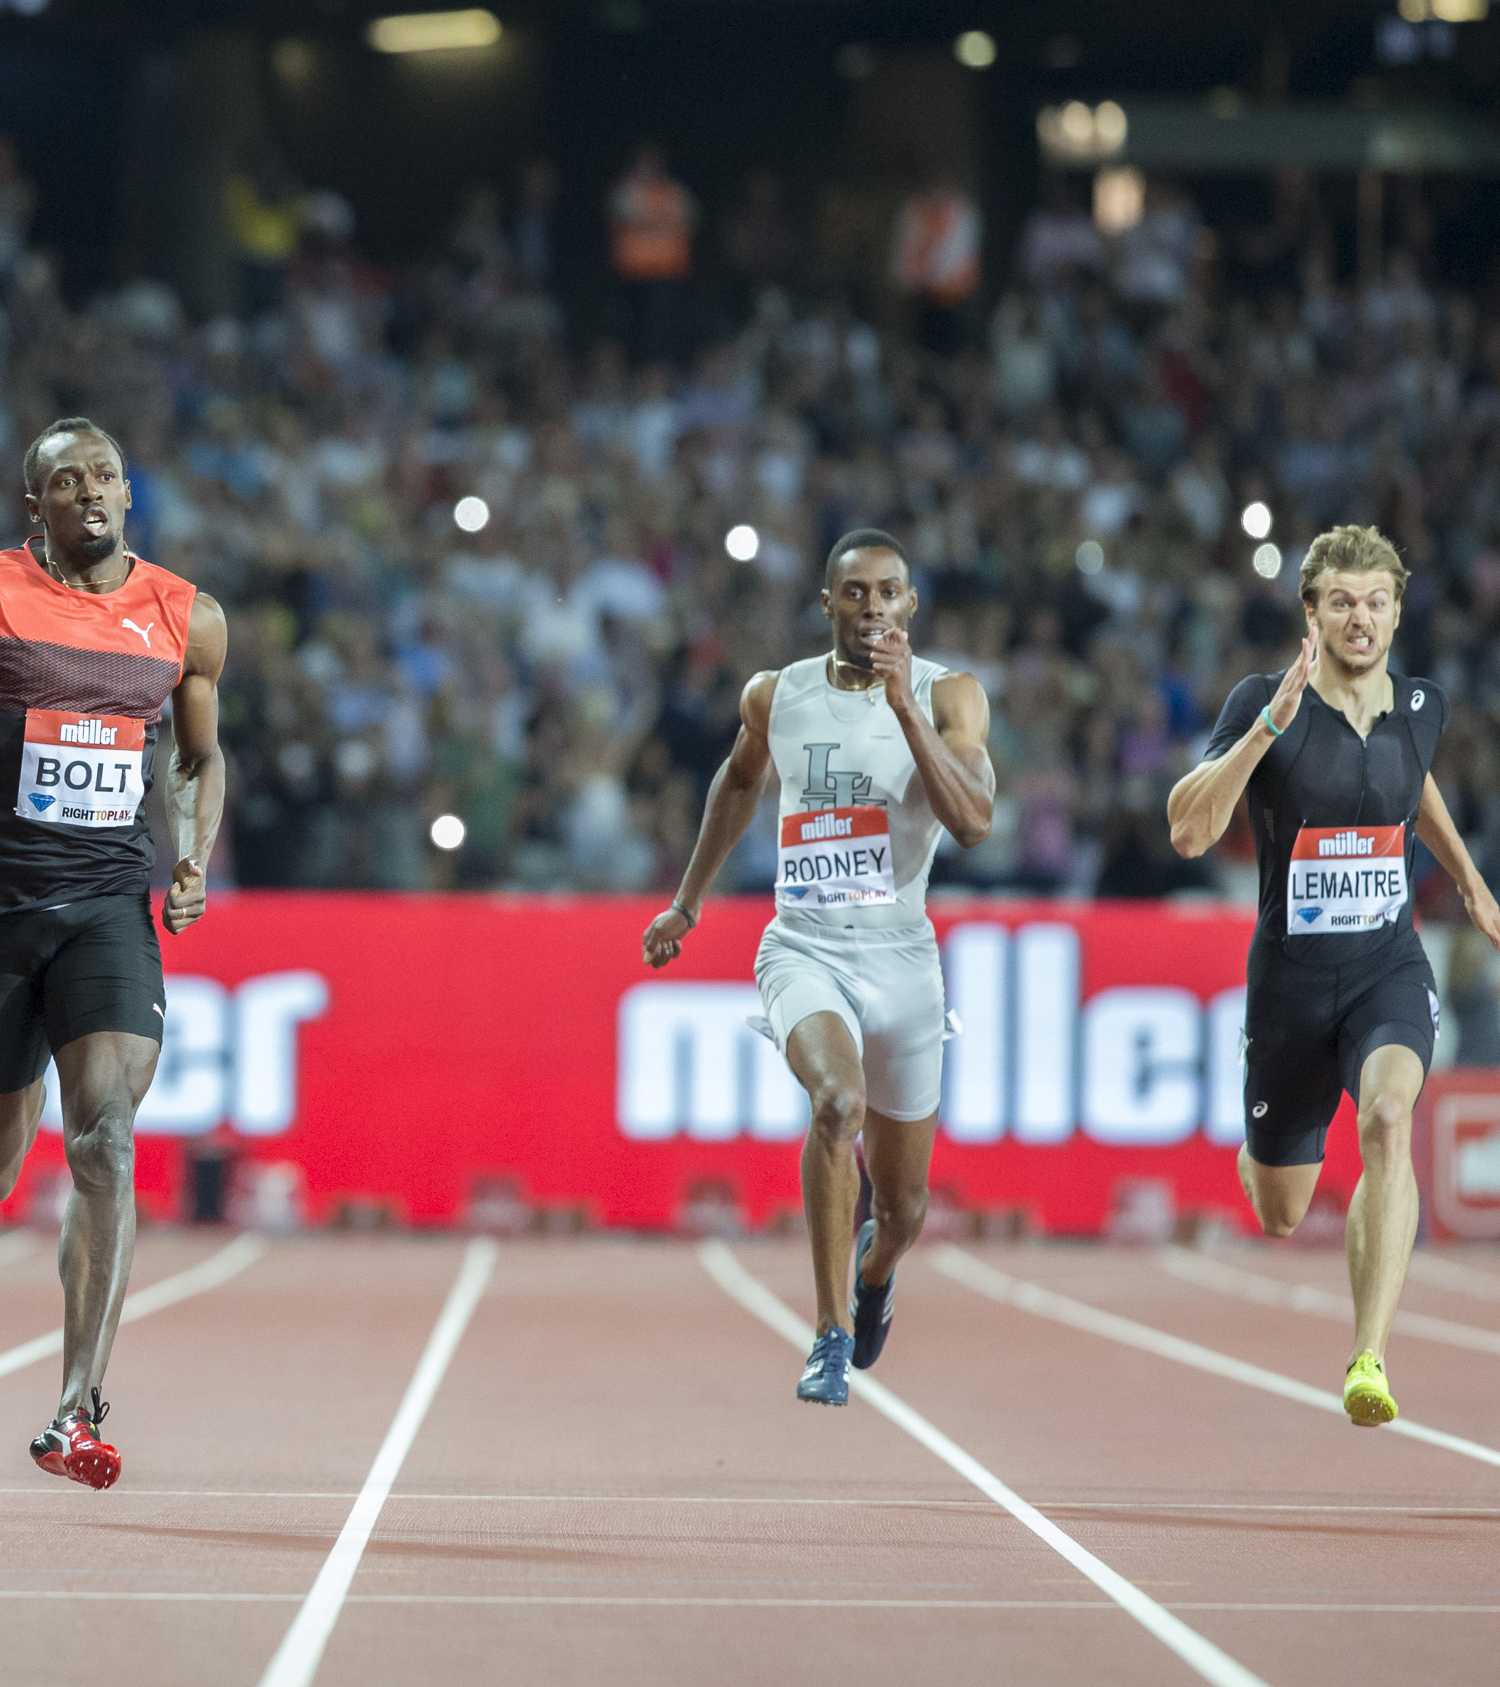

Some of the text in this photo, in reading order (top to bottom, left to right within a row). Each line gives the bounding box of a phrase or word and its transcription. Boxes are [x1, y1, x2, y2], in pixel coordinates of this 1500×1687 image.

[60, 719, 117, 746] müller
[35, 757, 131, 793] BOLT
[800, 812, 853, 841] müller
[1318, 831, 1375, 857] müller
[784, 847, 886, 883] RODNEY
[1292, 870, 1402, 900] LEMAITRE
